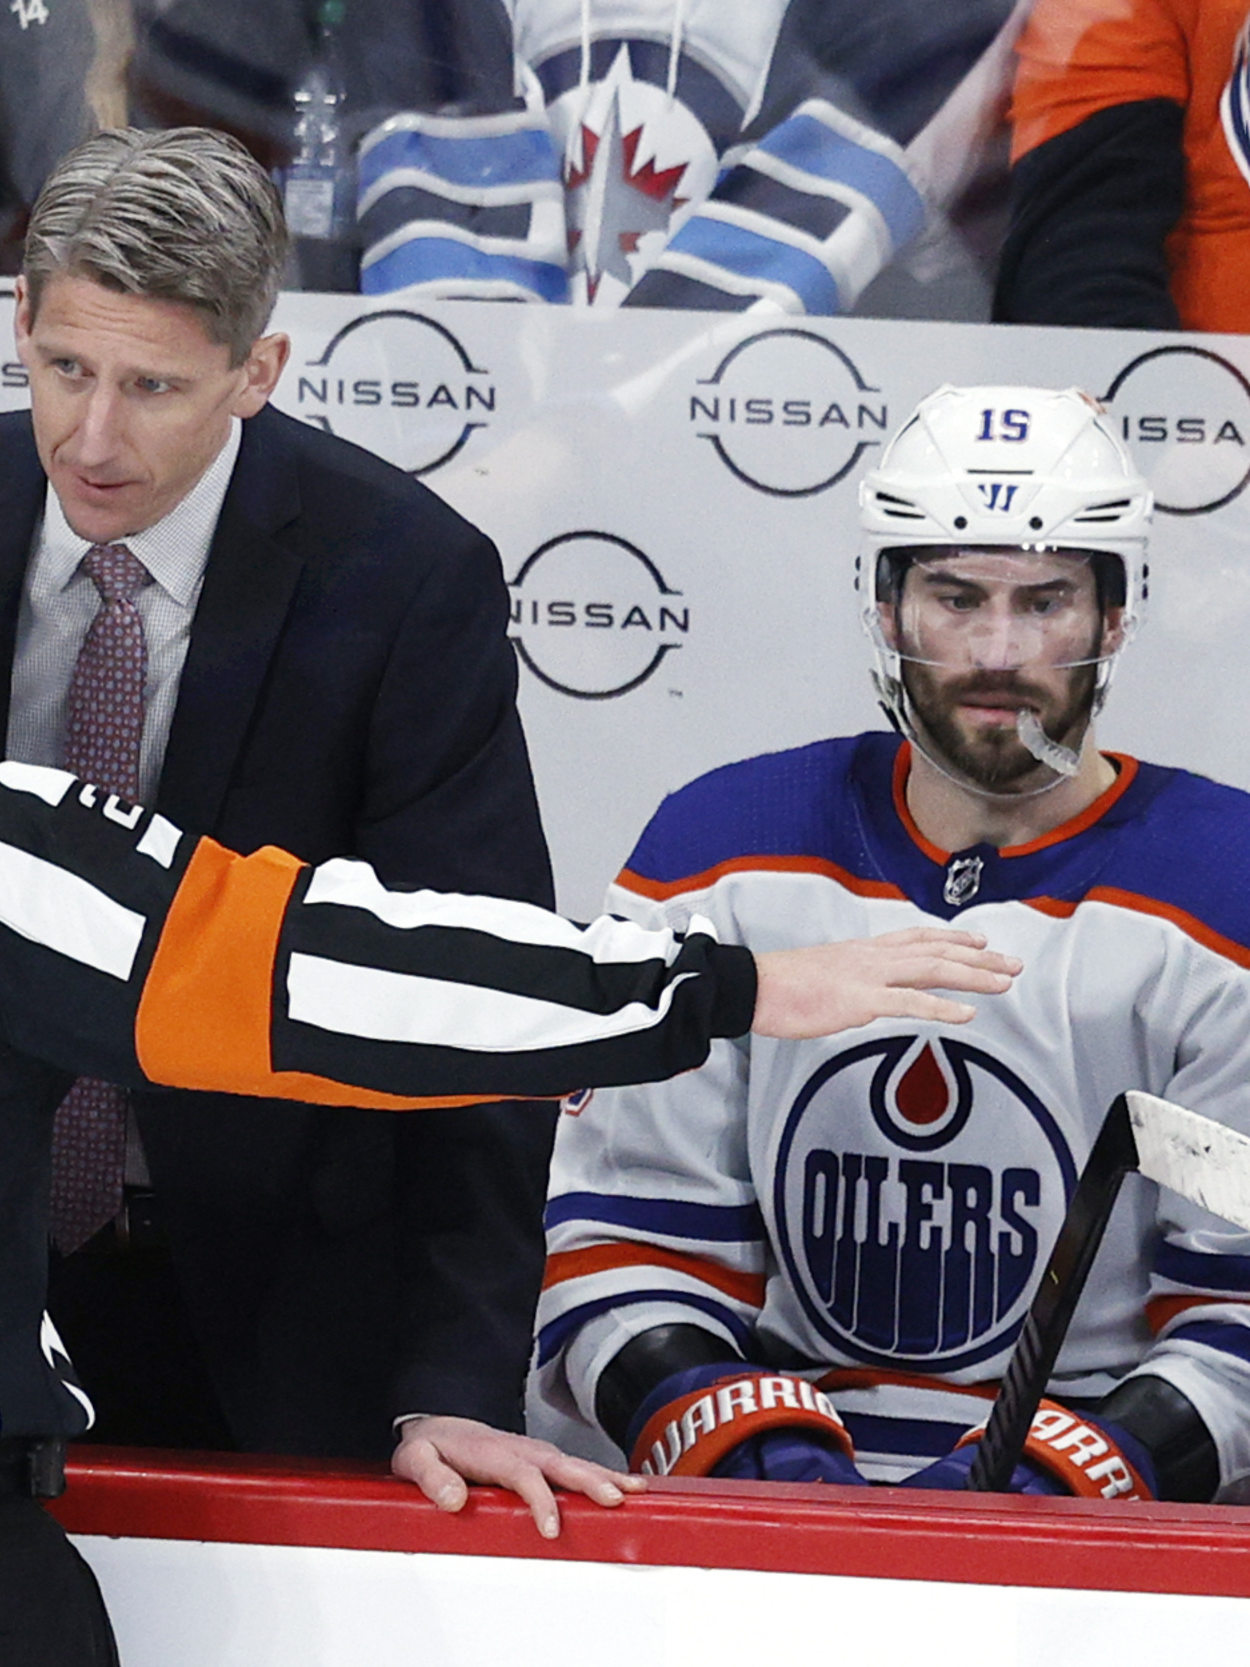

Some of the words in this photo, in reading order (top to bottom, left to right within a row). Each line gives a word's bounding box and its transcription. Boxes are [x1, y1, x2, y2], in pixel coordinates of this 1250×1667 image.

[298, 377, 495, 411] NISSAN
[690, 396, 887, 430] NISSAN
[976, 408, 1031, 442] 15
[1122, 415, 1246, 447] ISSA
[802, 1147, 1041, 1280] OILERS
[641, 1381, 844, 1477] WARRIO
